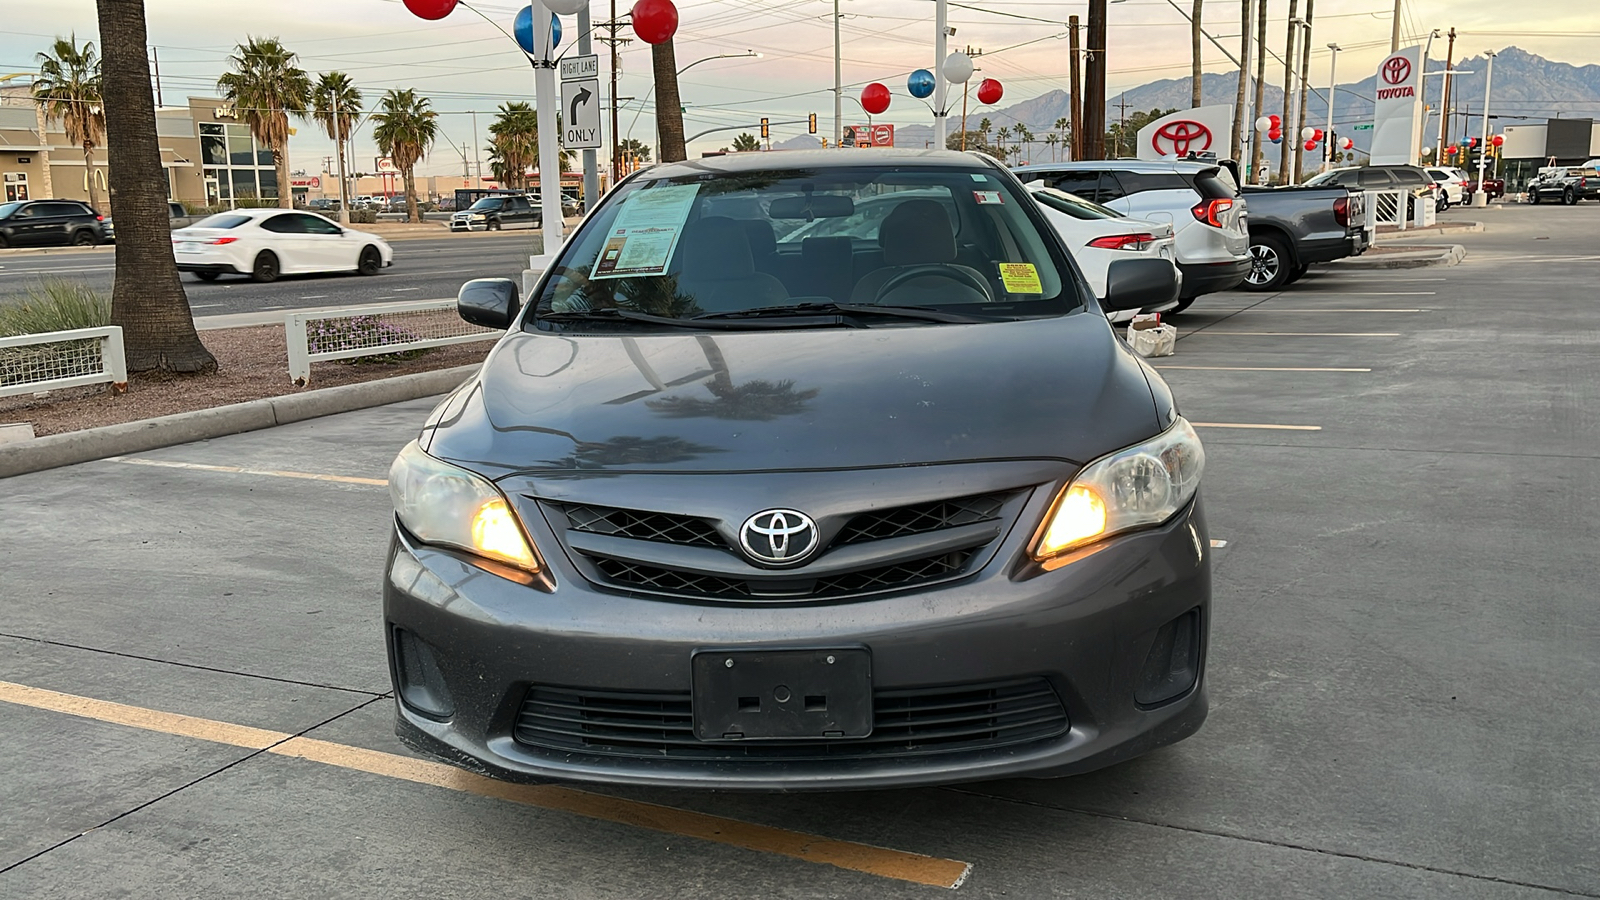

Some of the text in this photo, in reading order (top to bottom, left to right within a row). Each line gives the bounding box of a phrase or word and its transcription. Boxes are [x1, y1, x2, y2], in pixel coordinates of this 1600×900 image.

[563, 60, 596, 74] RIGHT LANE
[1377, 86, 1414, 100] TOYOTA
[568, 128, 596, 142] ONLY
